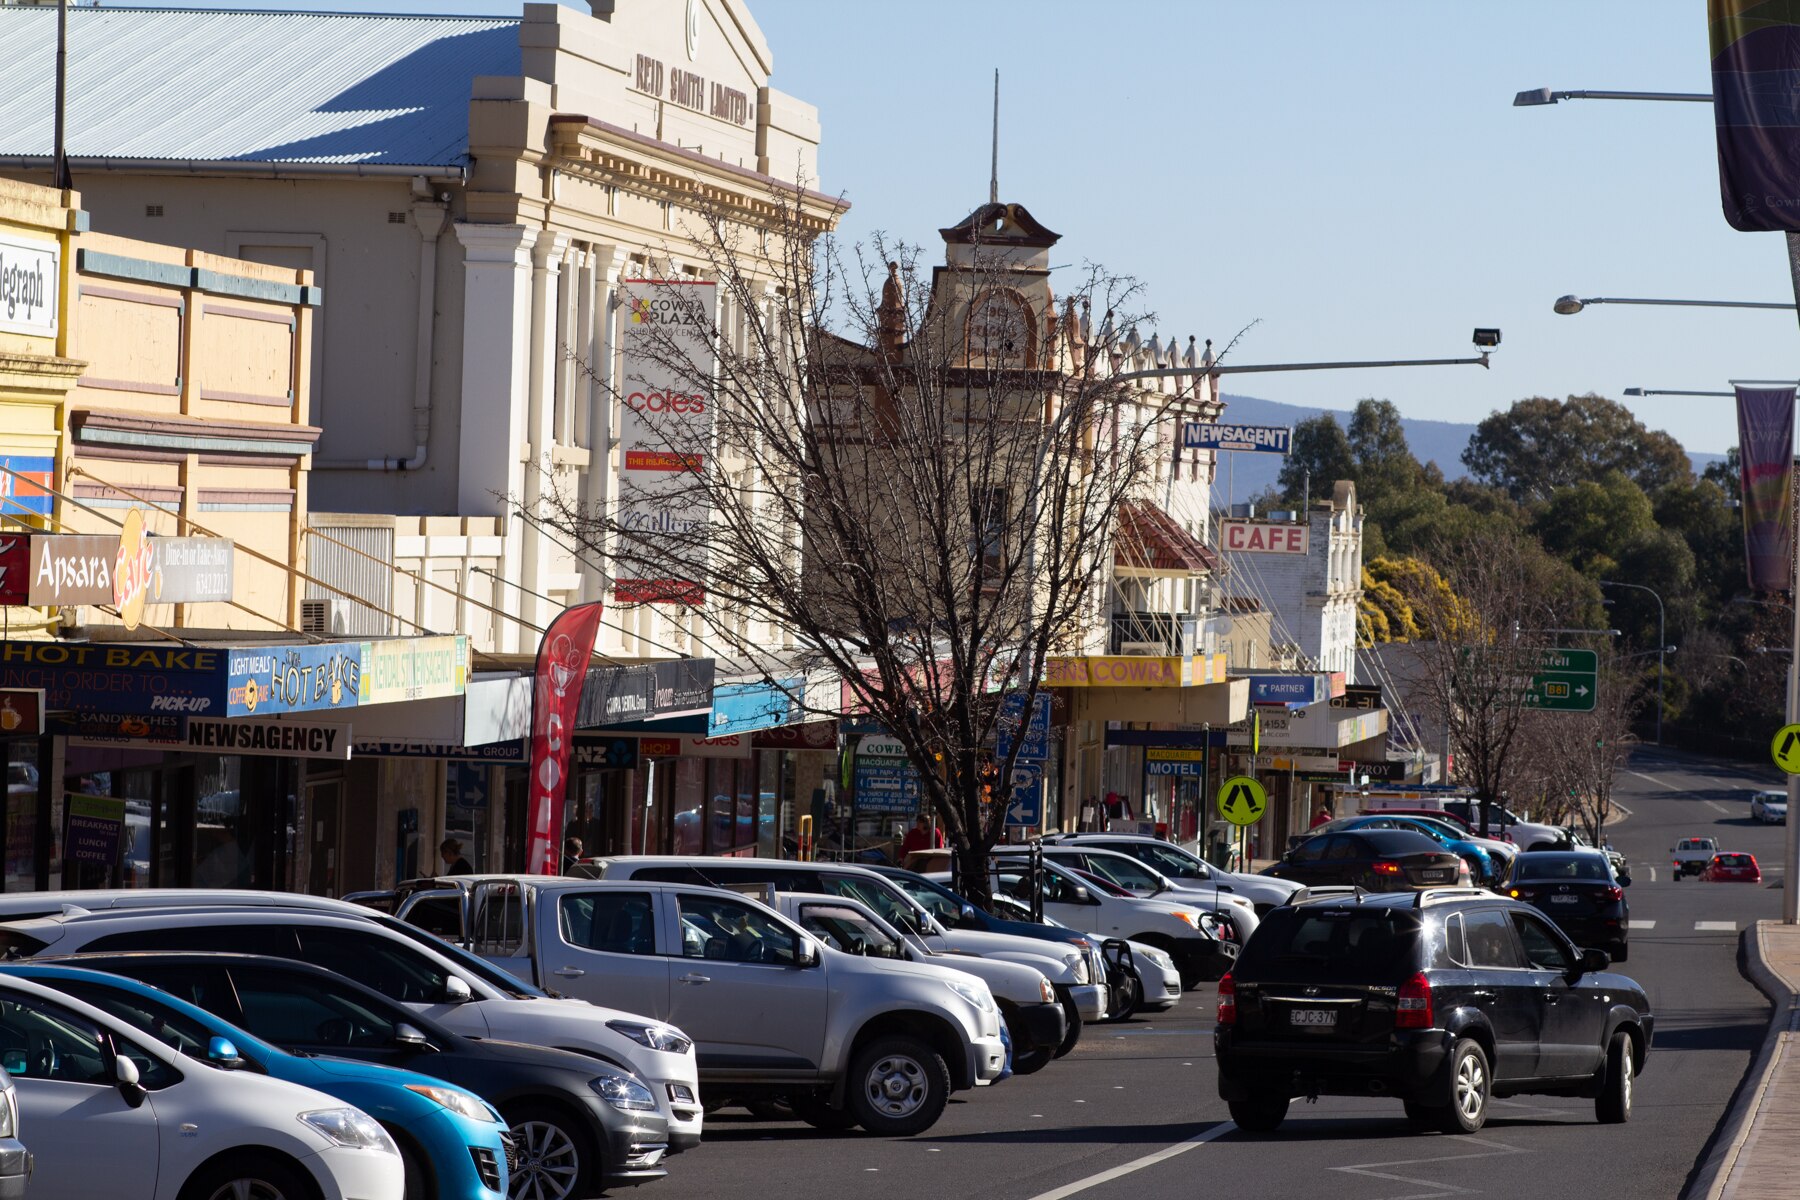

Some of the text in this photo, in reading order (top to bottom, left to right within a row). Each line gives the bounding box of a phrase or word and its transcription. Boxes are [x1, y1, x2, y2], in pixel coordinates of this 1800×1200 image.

[636, 53, 748, 126] REID SMITH LIMITED
[650, 312, 707, 326] PLAZA
[627, 389, 705, 414] coles
[1187, 424, 1288, 449] NEWSAGENT
[1228, 526, 1302, 551] CAFE
[36, 540, 110, 599] Apsara
[4, 644, 218, 671] HOT BAKE
[230, 655, 271, 676] LIGHT MEALS
[270, 655, 360, 706] HOT BAKE
[1094, 661, 1176, 683] COWRA
[1270, 684, 1305, 693] PARTNER
[150, 695, 211, 713] PICK-UP
[188, 721, 338, 753] NEWSAGENCY
[483, 746, 520, 758] GROUP
[571, 745, 608, 764] NZ
[867, 744, 906, 754] COWR
[1149, 763, 1198, 776] MOTEL
[71, 818, 119, 832] BREAKFAST
[78, 838, 107, 848] LUNCH
[75, 849, 106, 861] COFFEE
